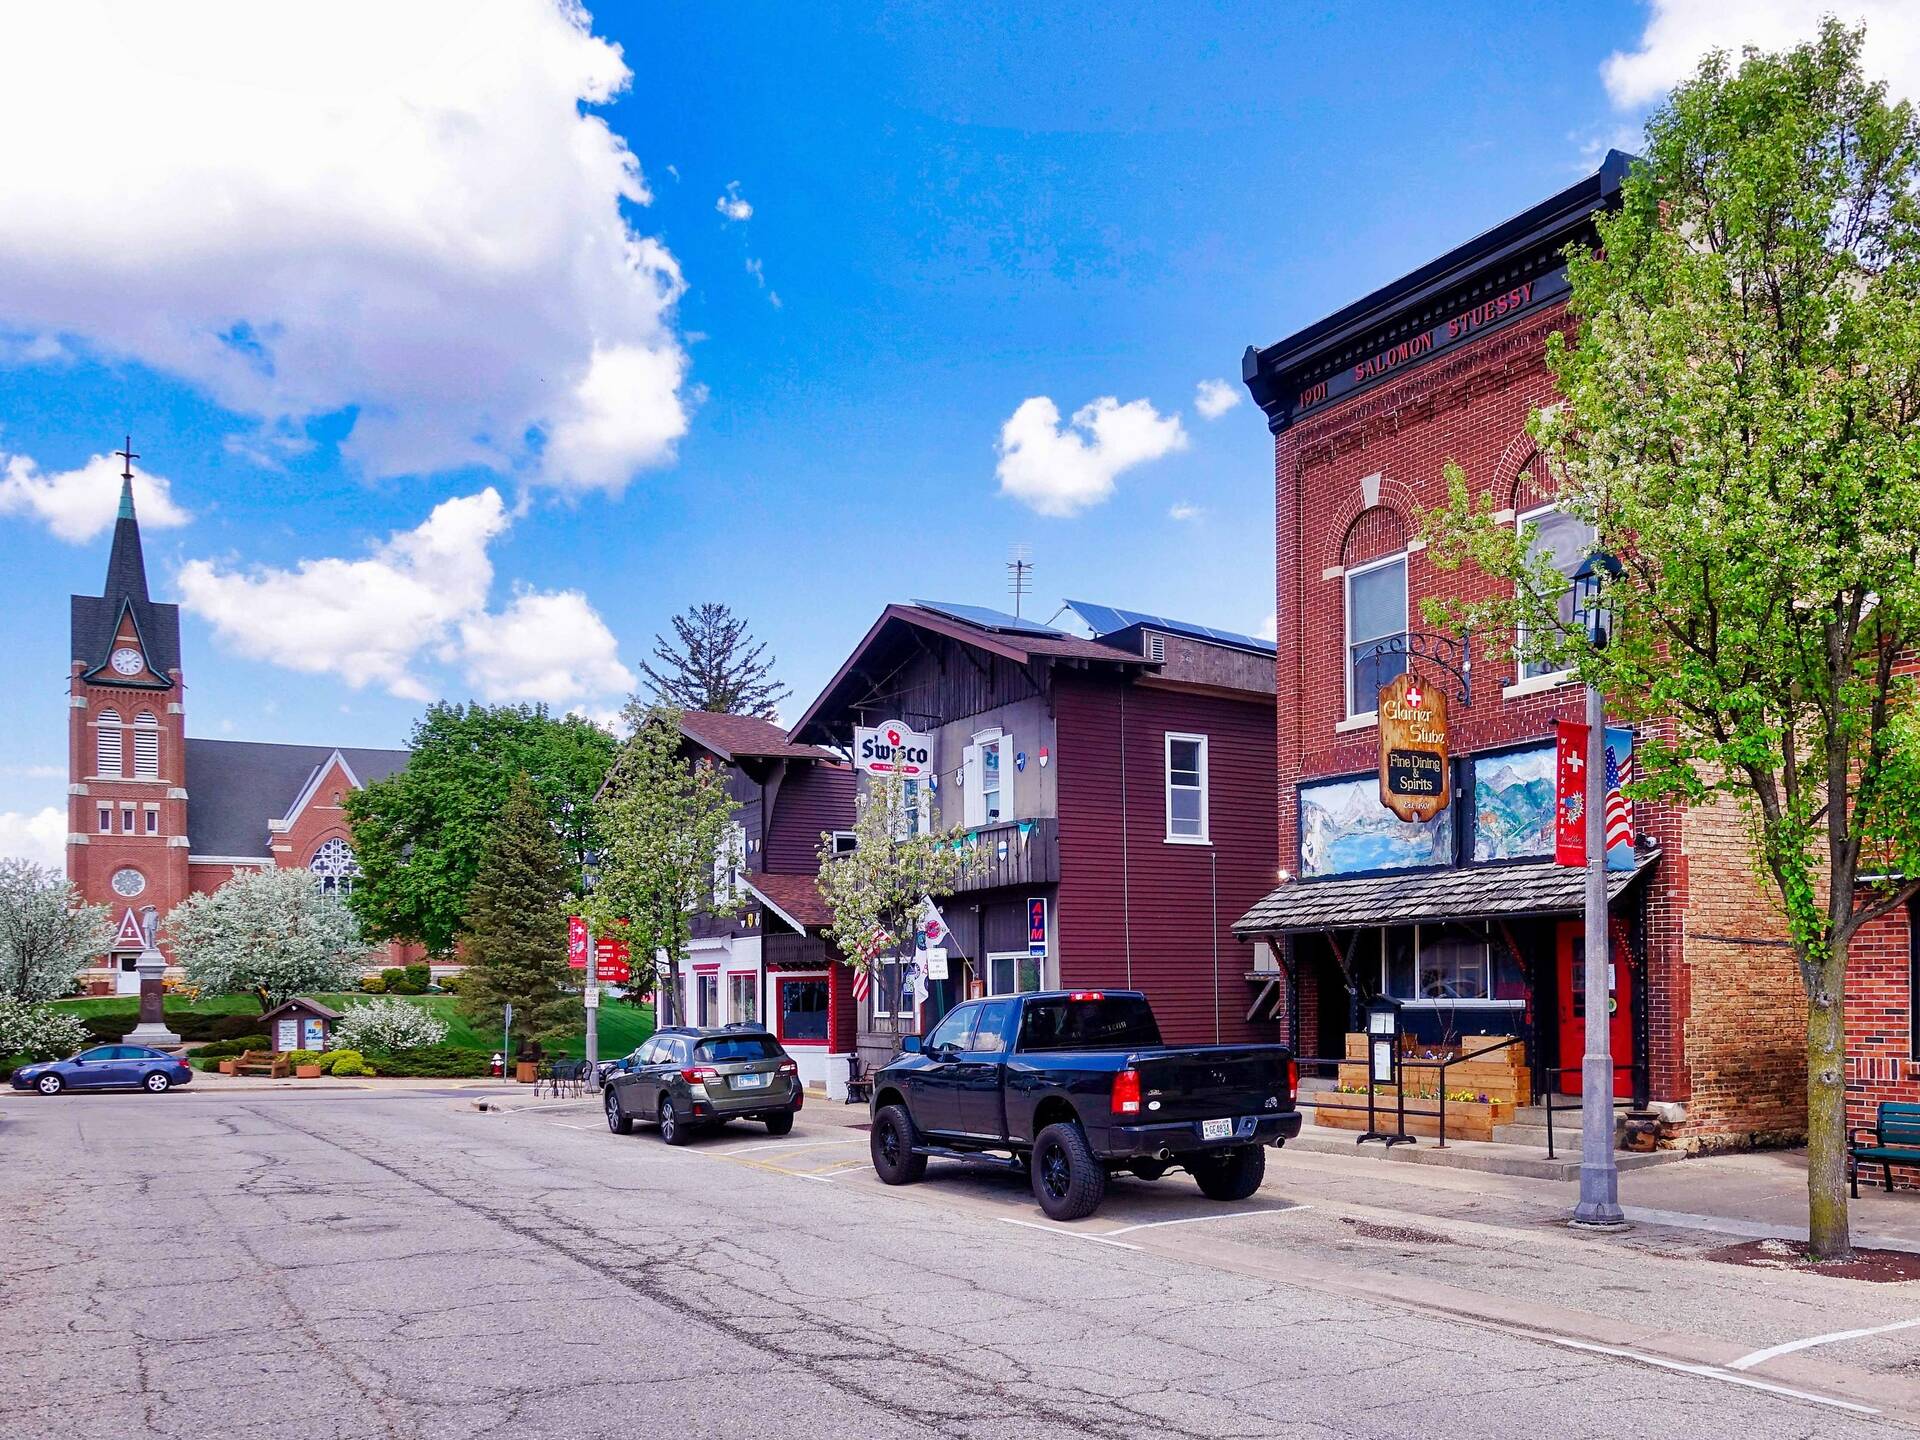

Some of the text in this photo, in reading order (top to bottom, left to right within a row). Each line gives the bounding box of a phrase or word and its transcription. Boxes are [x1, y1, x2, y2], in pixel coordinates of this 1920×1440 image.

[1299, 282, 1534, 409] 1901 SALOMON STUESSY
[1383, 700, 1433, 722] Glarner
[1409, 724, 1446, 744] Stube
[1390, 754, 1440, 772] Fine Dining
[1412, 767, 1420, 778] &
[1400, 776, 1433, 791] Spirits
[1559, 737, 1568, 835] WILLKOMMEN
[1030, 902, 1043, 940] ATM
